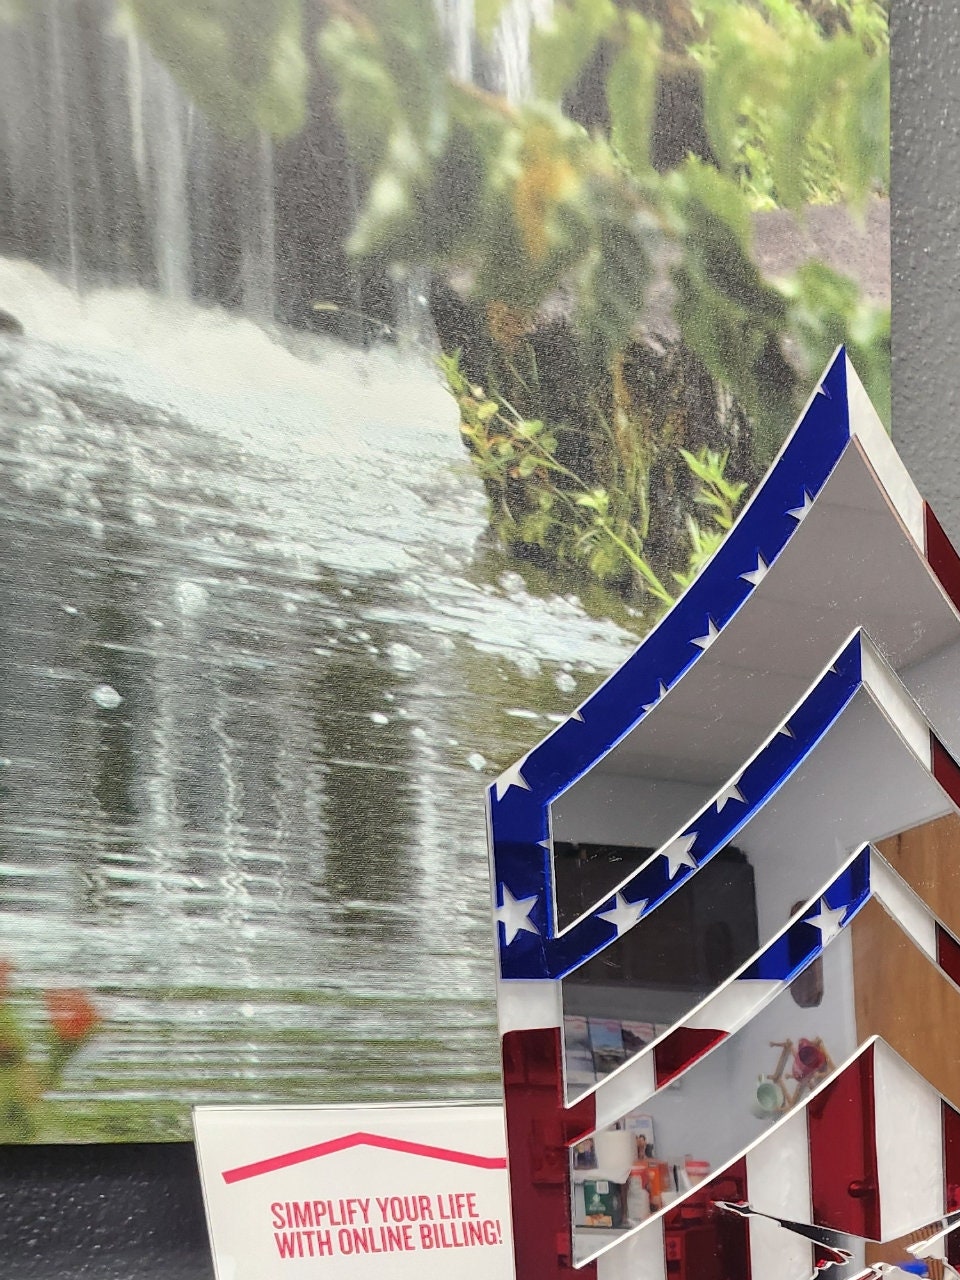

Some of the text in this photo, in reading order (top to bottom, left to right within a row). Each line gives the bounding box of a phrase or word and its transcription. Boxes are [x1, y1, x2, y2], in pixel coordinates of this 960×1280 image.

[270, 1193, 480, 1229] SIMPLIFY YOUR LIFE
[274, 1219, 503, 1259] WITH ONLINE BILLING!
